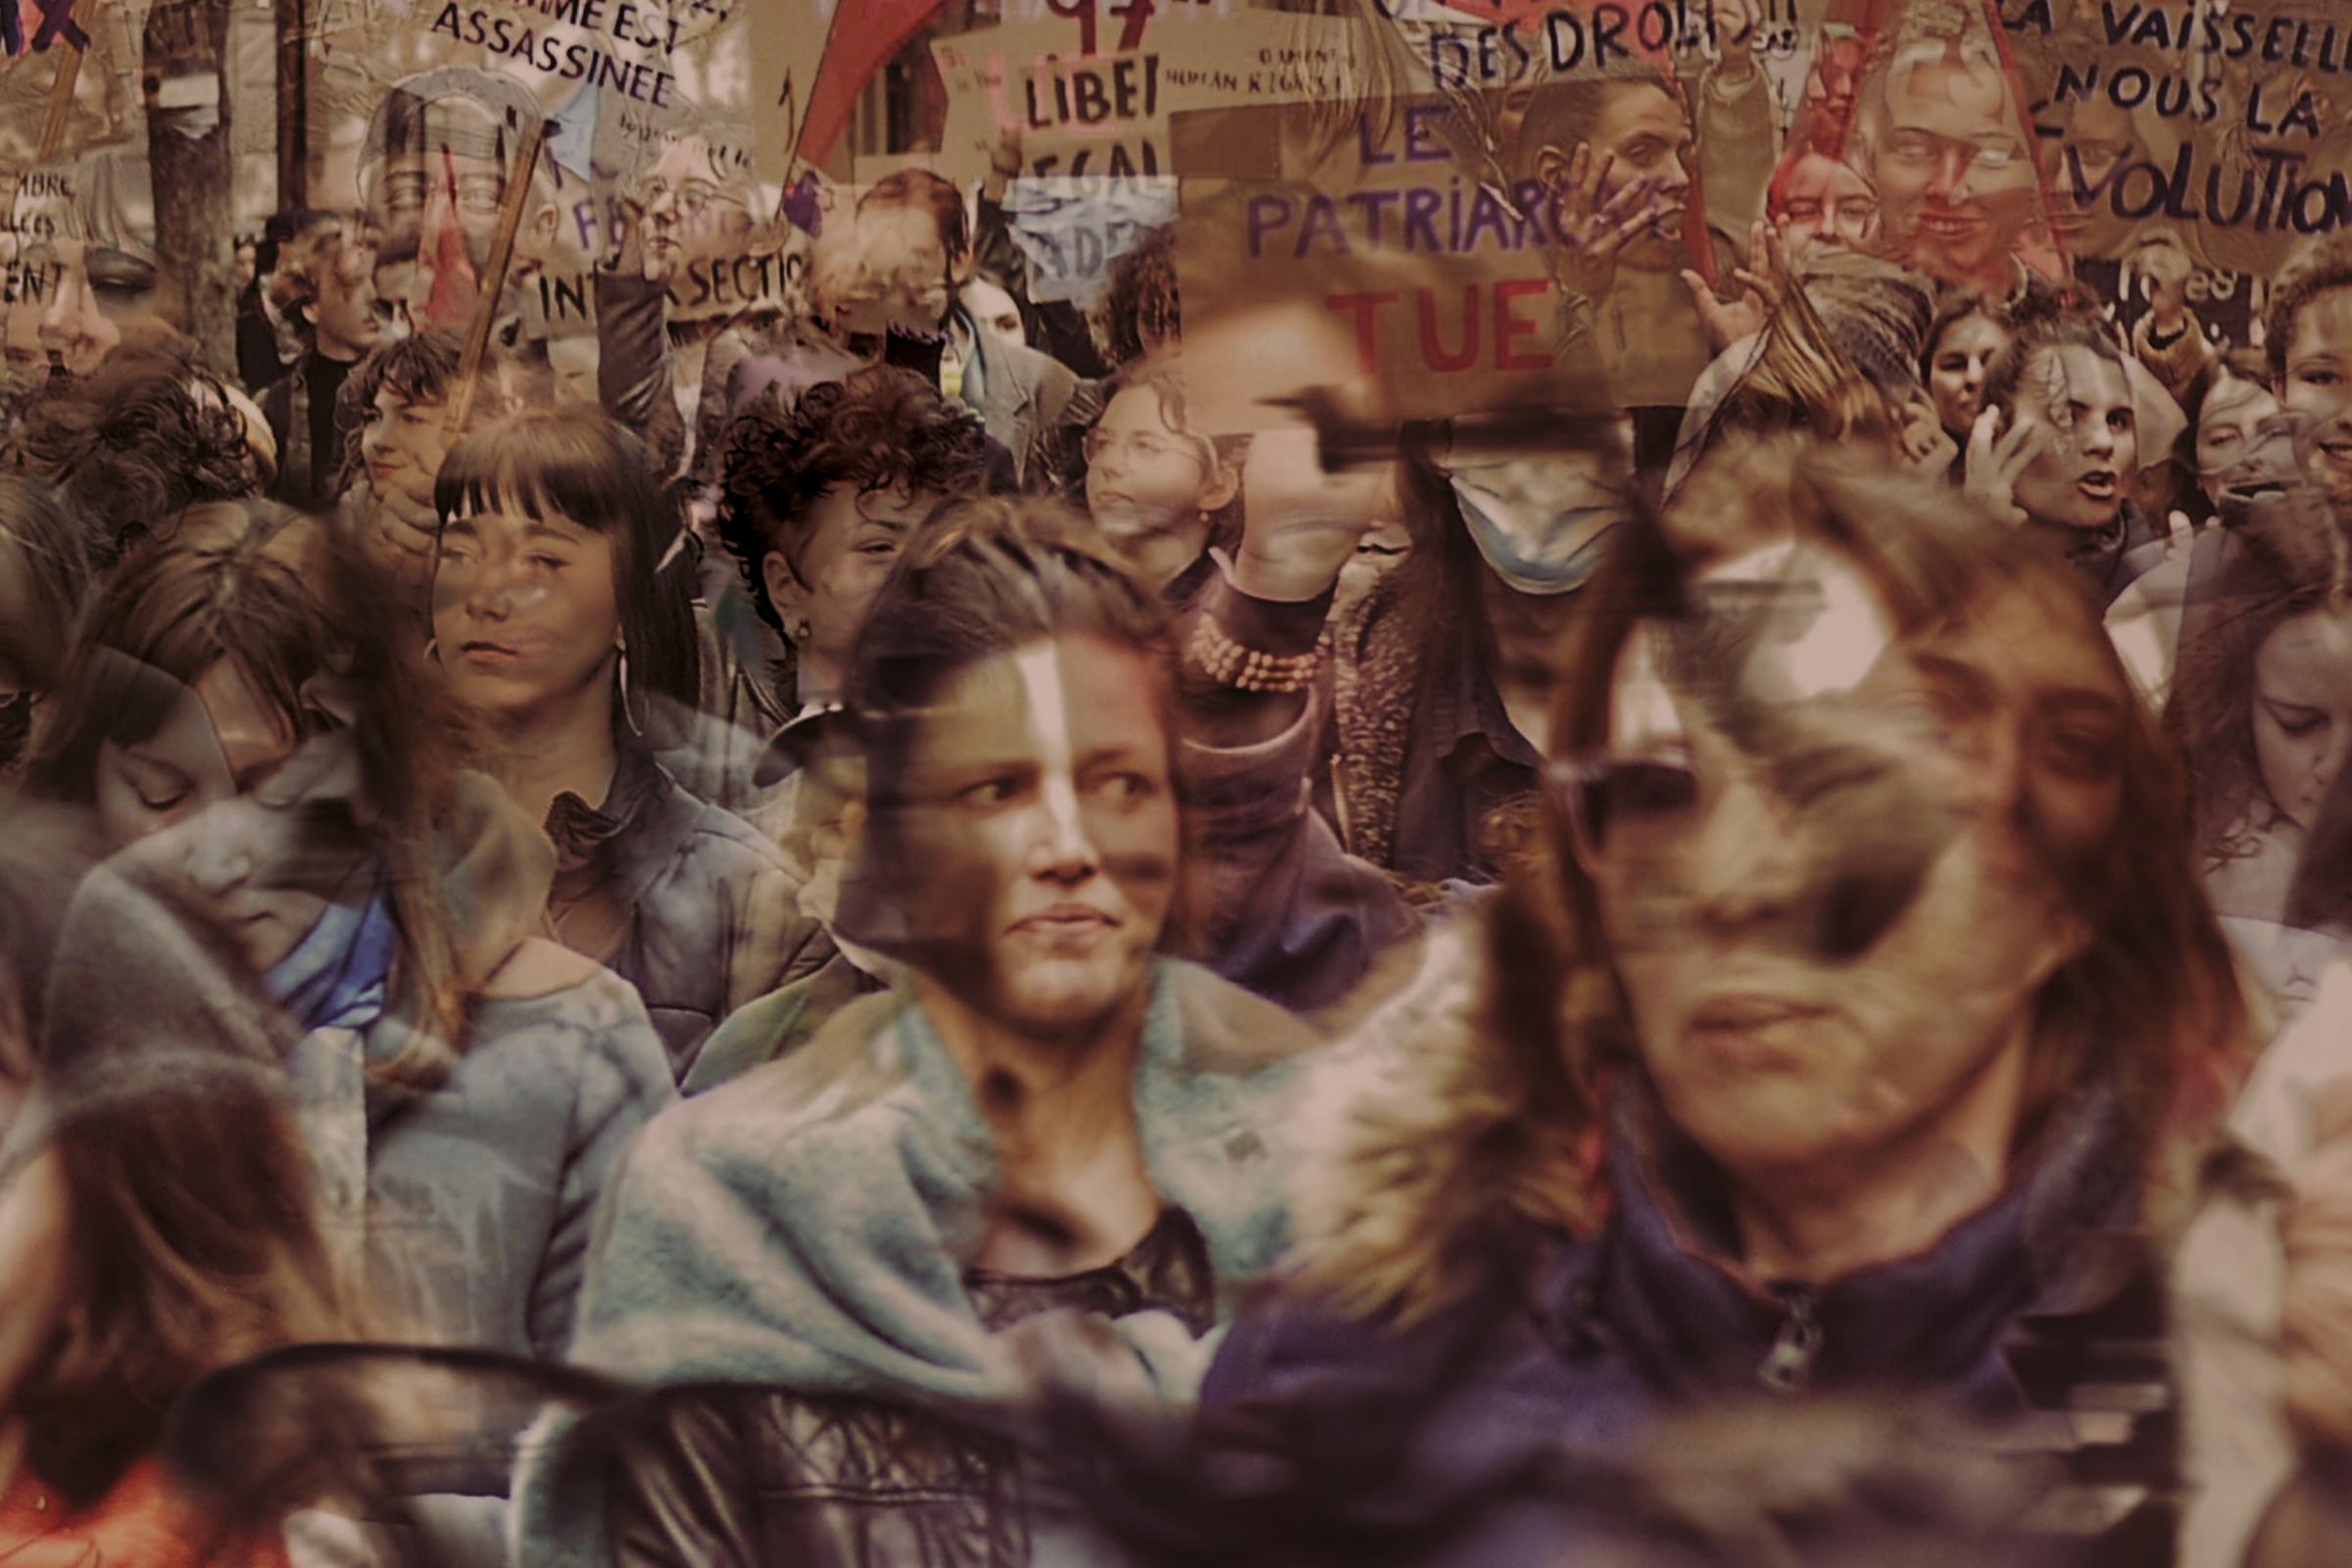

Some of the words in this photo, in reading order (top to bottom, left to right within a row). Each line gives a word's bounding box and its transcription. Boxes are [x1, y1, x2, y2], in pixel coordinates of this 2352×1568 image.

[1359, 104, 1452, 165] LE
[2054, 63, 2222, 123] NOUS
[2246, 83, 2320, 138] LA
[1325, 278, 1555, 376] TUE
